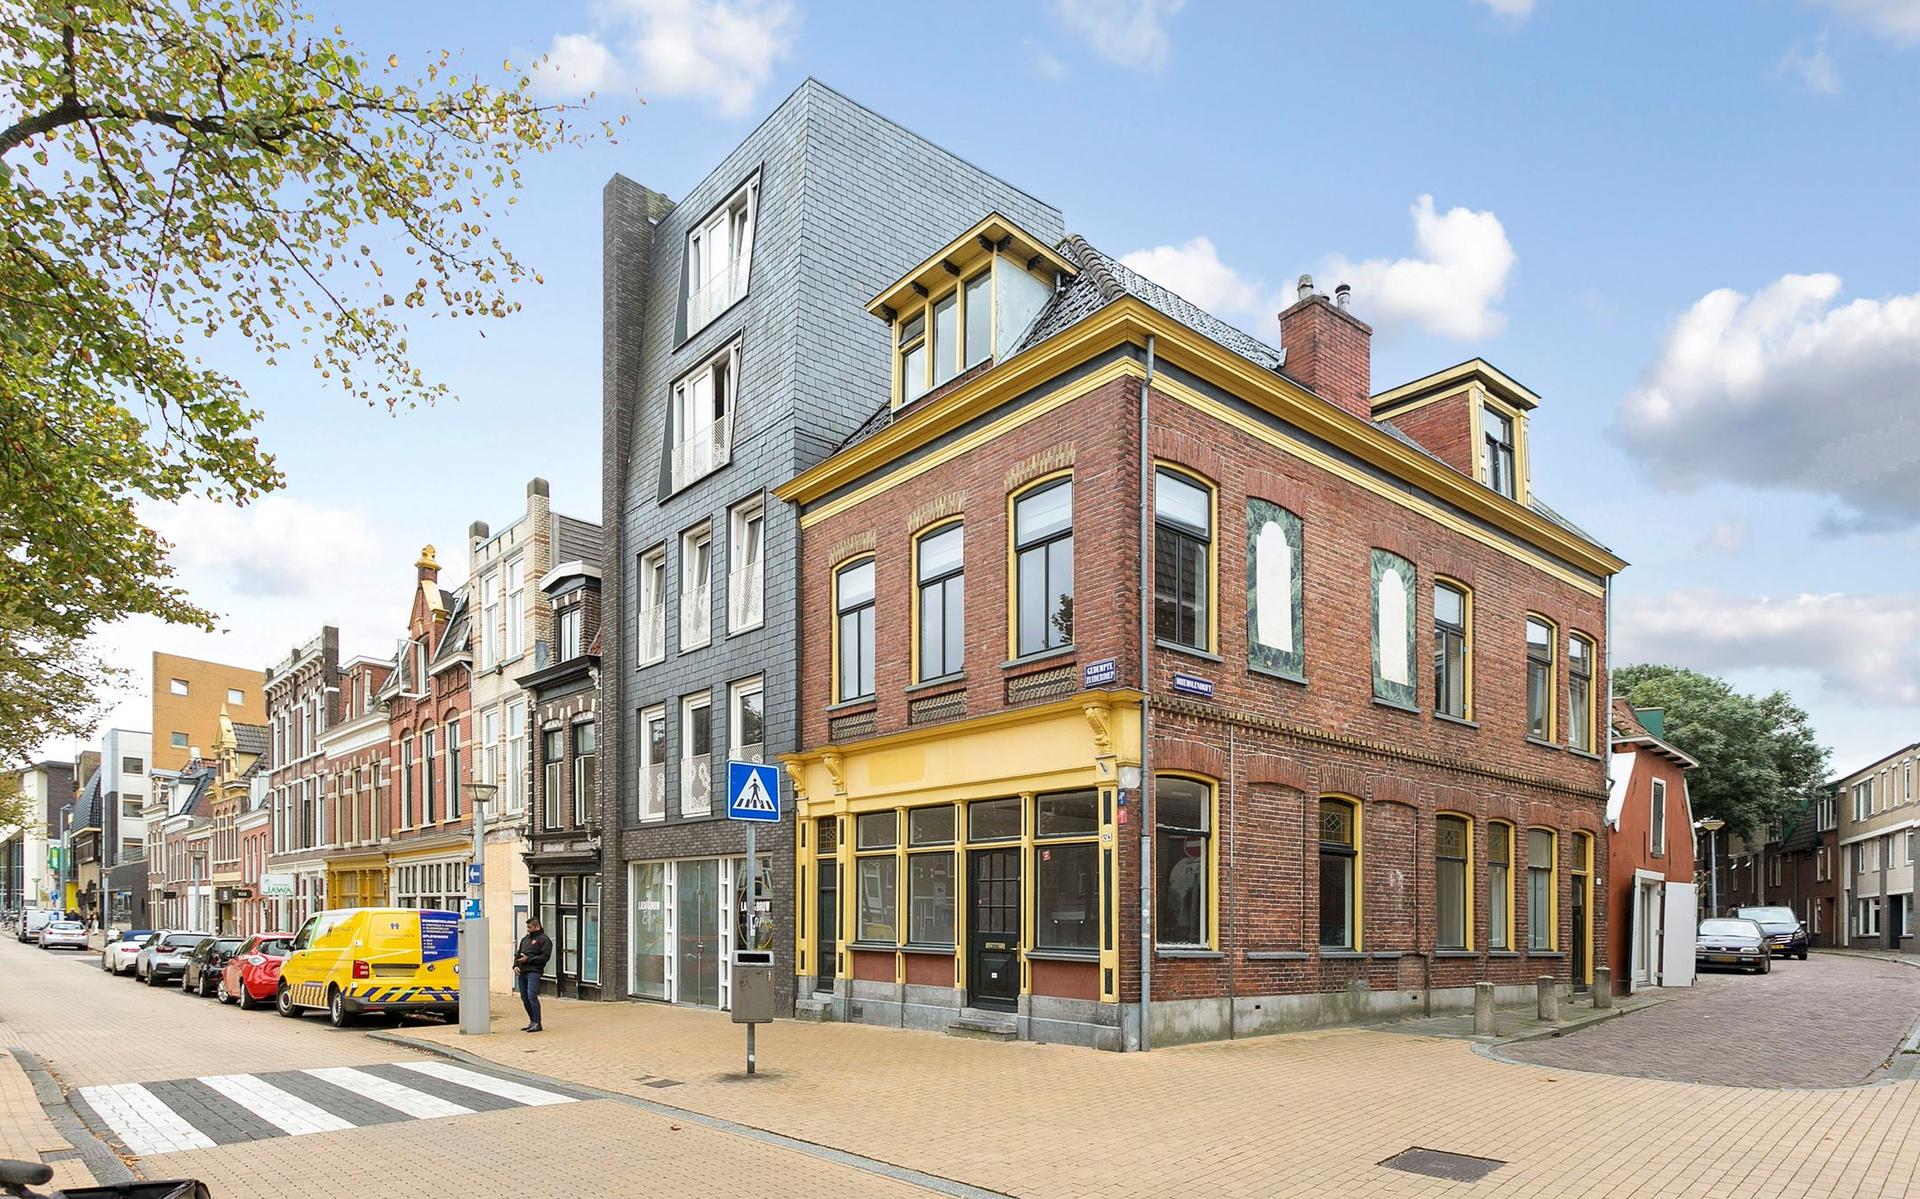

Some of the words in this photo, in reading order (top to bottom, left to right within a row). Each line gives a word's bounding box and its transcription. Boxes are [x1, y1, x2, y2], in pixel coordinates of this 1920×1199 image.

[1087, 662, 1114, 675] GEDEMPTE
[1086, 671, 1114, 684] ZUIDERDIEP
[262, 886, 293, 894] JAWA
